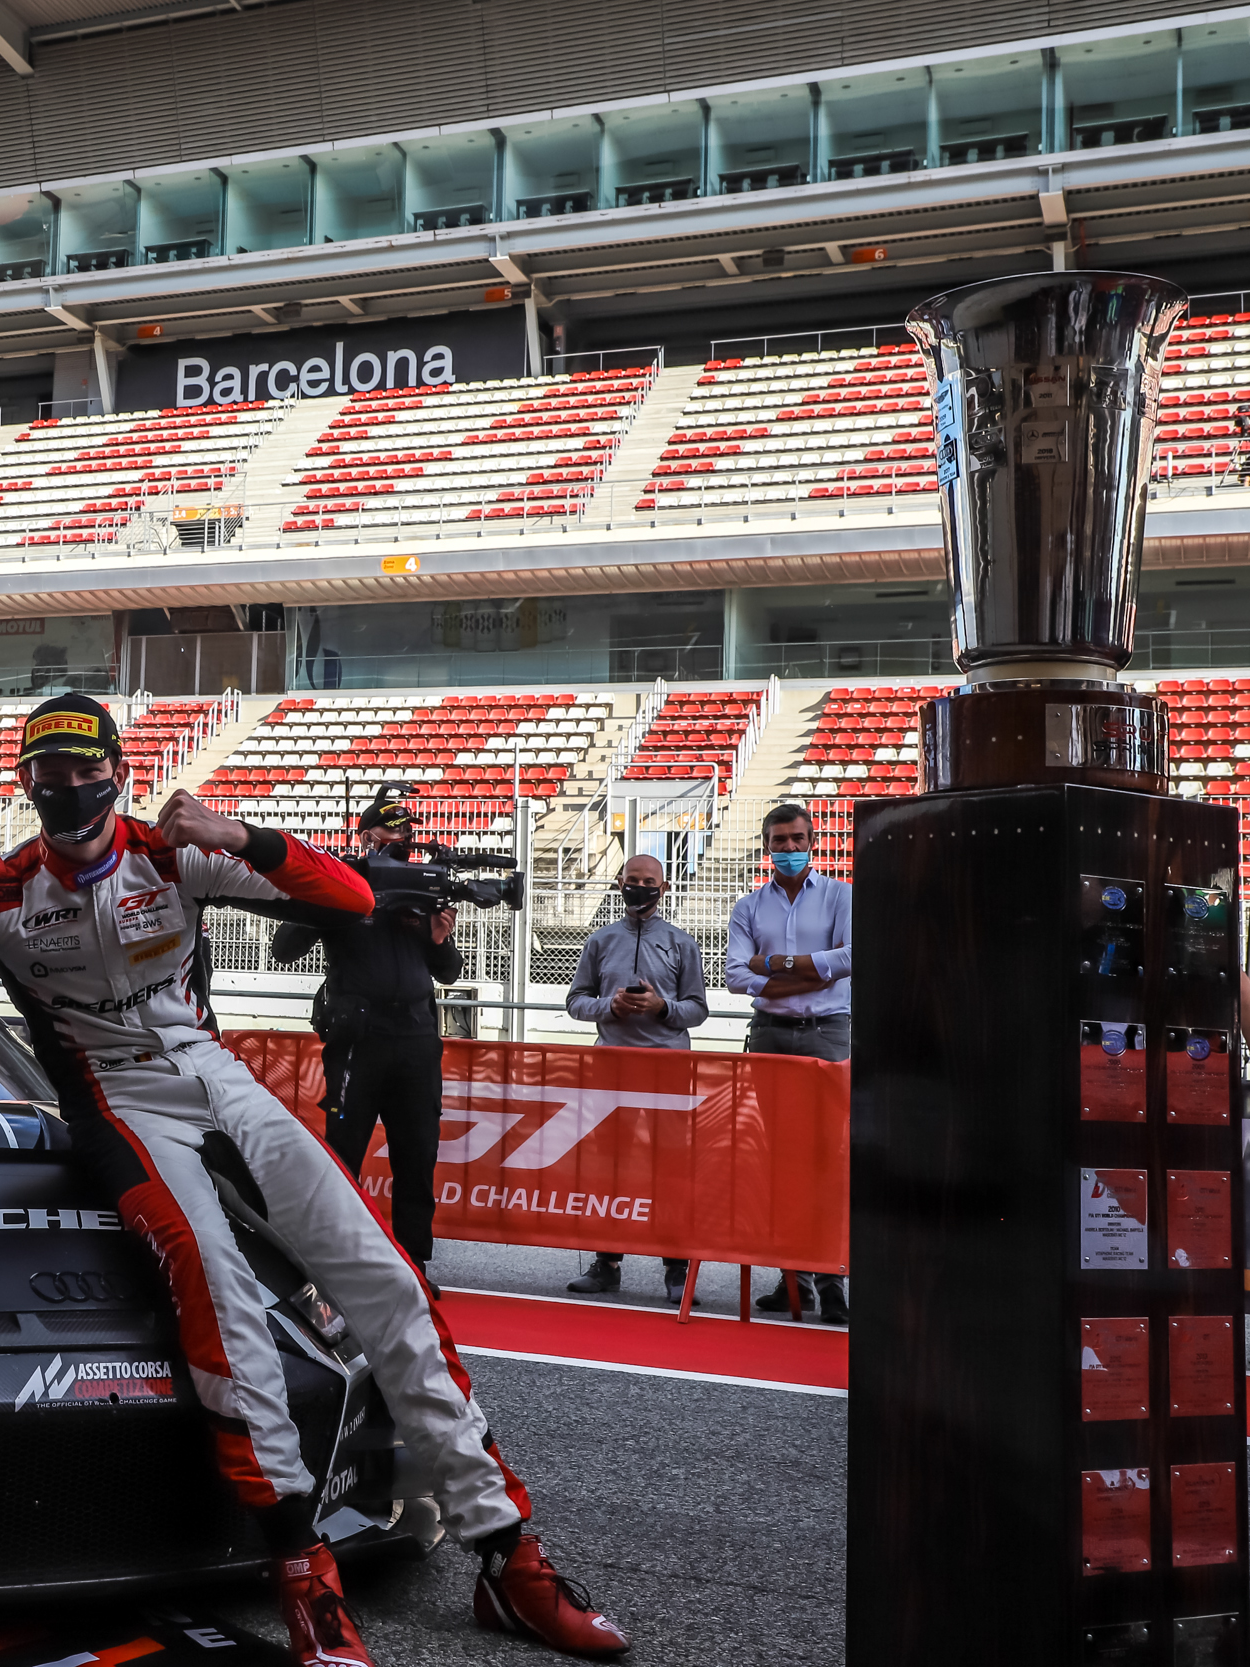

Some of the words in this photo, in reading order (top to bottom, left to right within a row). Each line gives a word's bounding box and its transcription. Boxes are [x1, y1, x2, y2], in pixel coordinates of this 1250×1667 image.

[874, 249, 885, 261] 6
[503, 289, 512, 299] 5
[153, 326, 161, 337] 4
[175, 341, 456, 407] Barcelona
[405, 557, 417, 572] 4
[30, 715, 93, 739] PIRELLI
[140, 904, 168, 915] CHALLENGE
[34, 907, 82, 928] WRT
[142, 918, 162, 929] aws
[26, 935, 81, 950] LENAERTS
[469, 1184, 652, 1223] CHALLENGE
[1107, 1205, 1121, 1213] 2010
[77, 1362, 132, 1380] ASSETTO
[132, 1361, 172, 1379] CORSA
[74, 1378, 173, 1399] COMPETIZIONE
[321, 1463, 358, 1504] TOTAL
[287, 1561, 310, 1574] OMP
